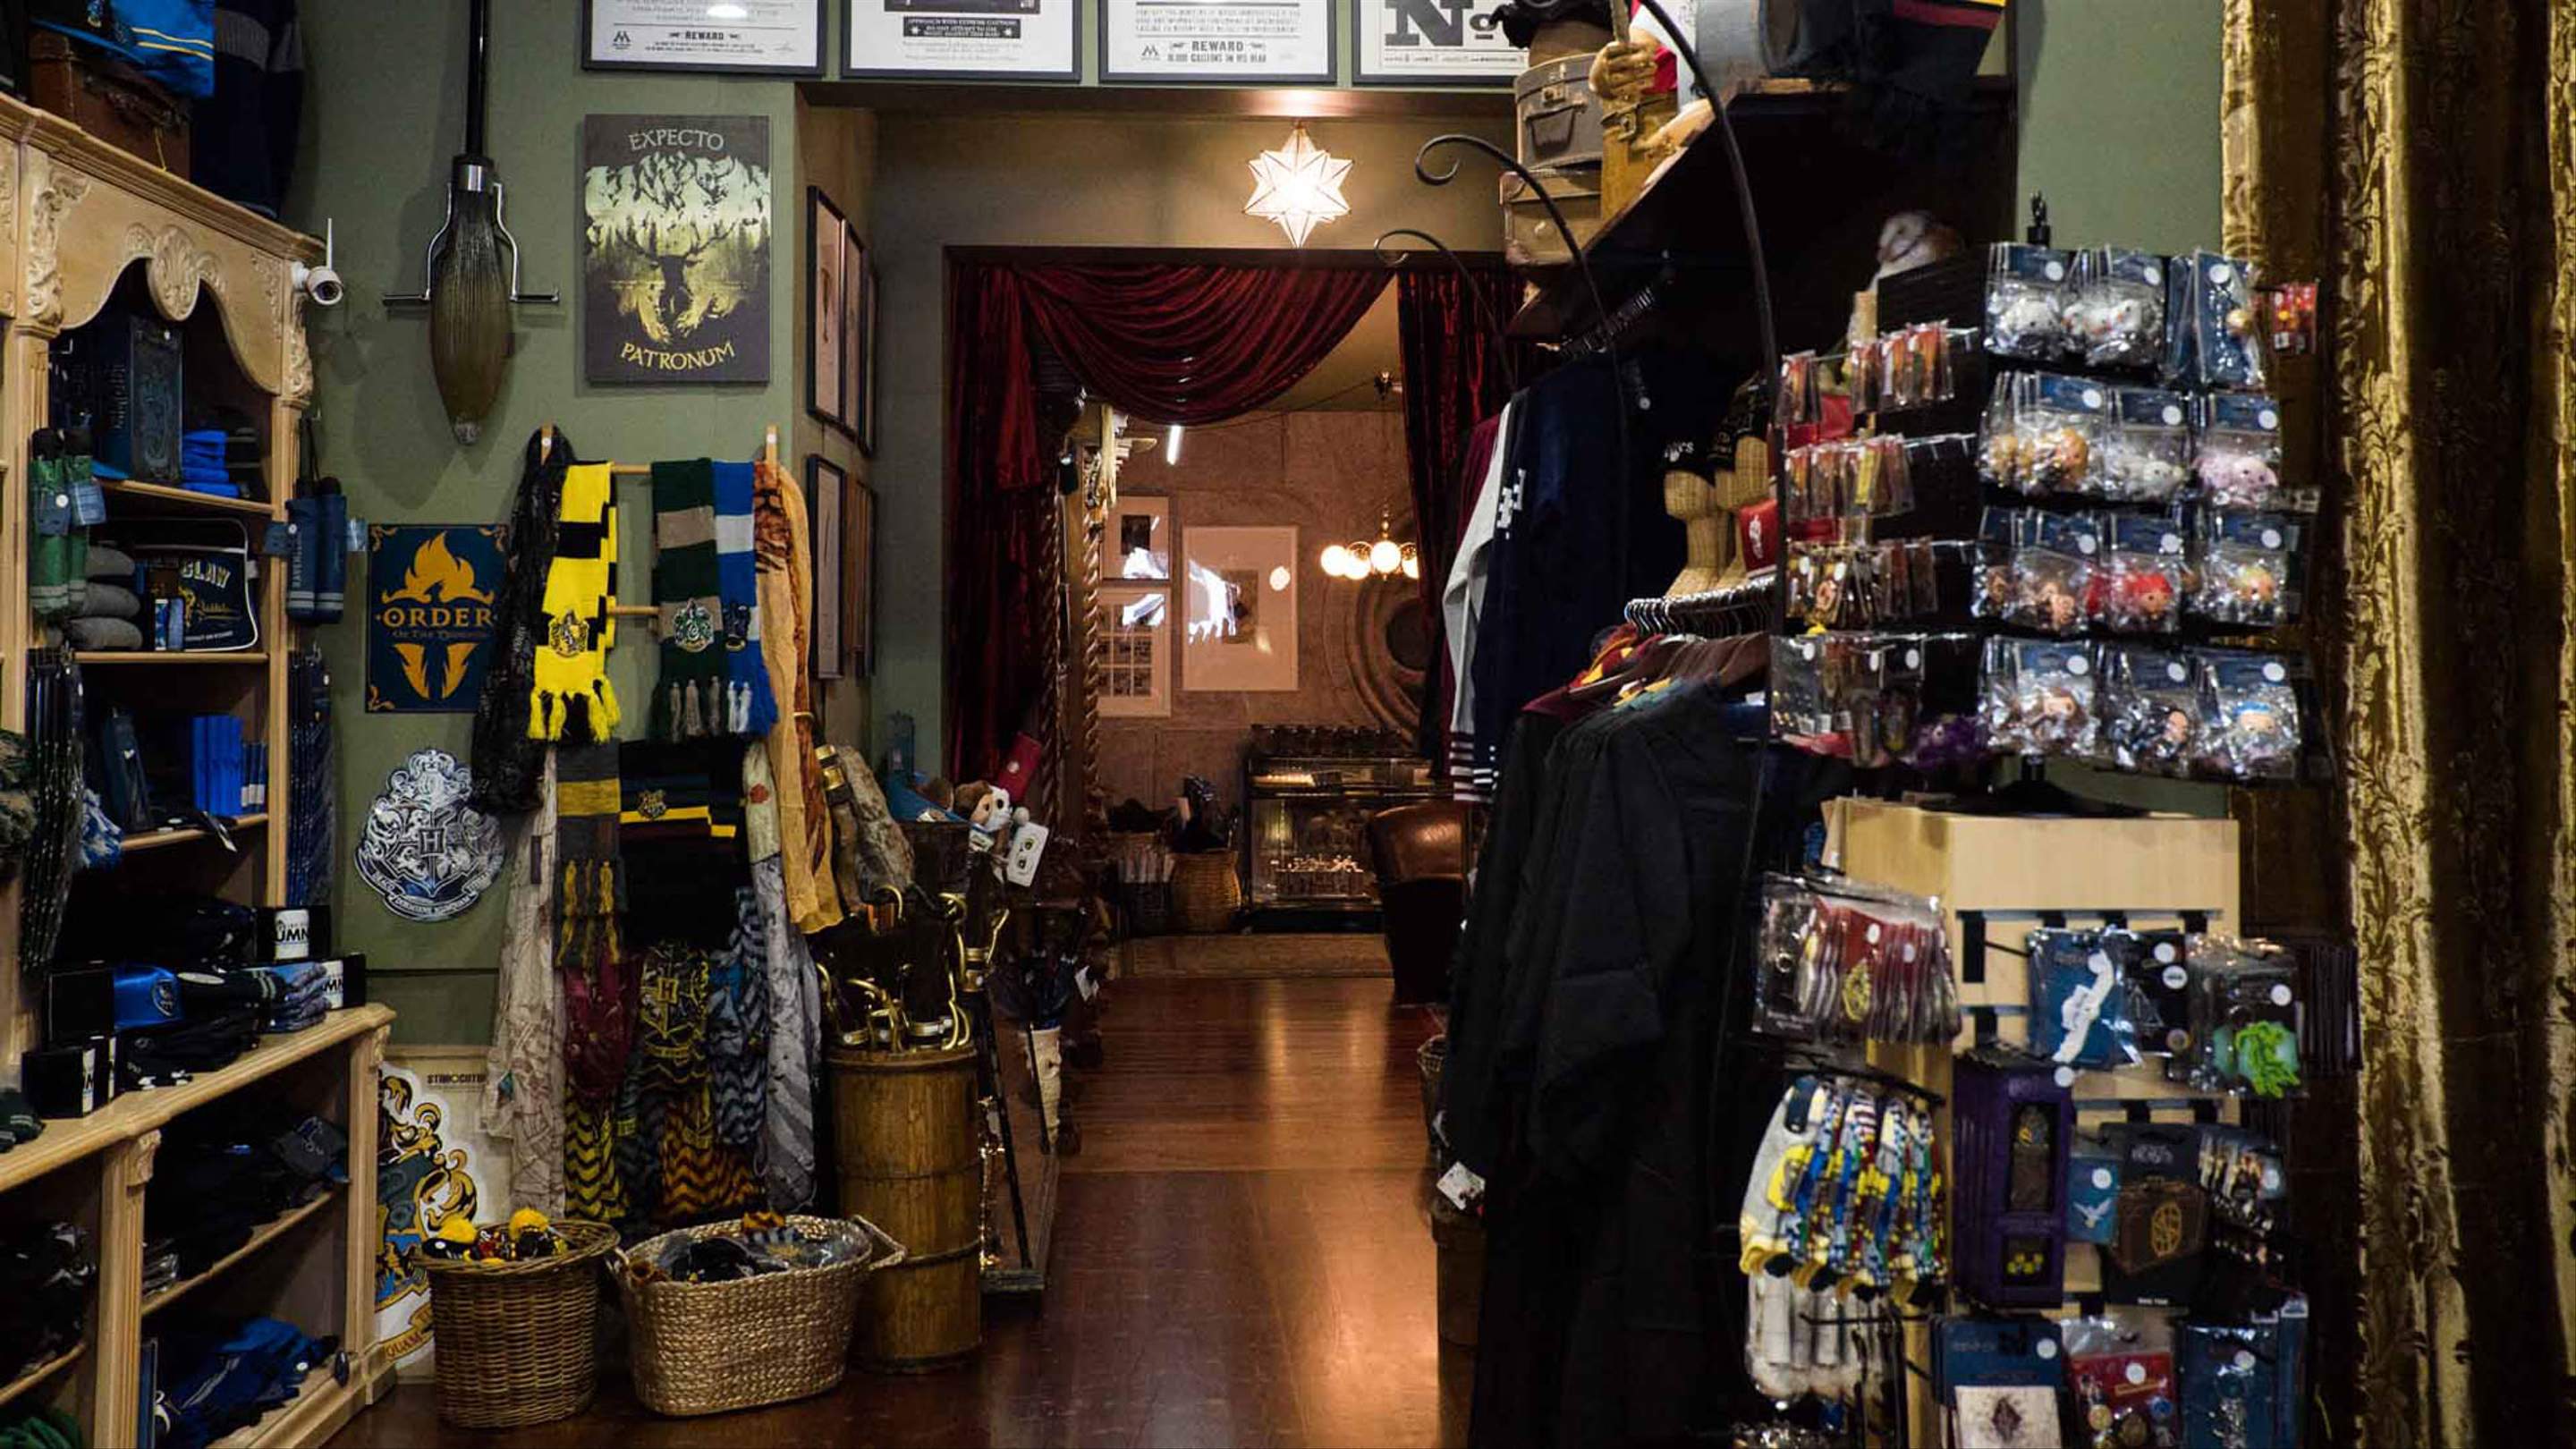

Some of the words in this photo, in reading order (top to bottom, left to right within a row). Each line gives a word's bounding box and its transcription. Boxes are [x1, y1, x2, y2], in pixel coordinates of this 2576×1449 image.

[685, 31, 724, 41] REWARD
[1191, 40, 1244, 52] REWARD
[628, 129, 724, 151] EXPECTO
[621, 342, 736, 371] PATRONUM
[382, 606, 495, 628] ORDER
